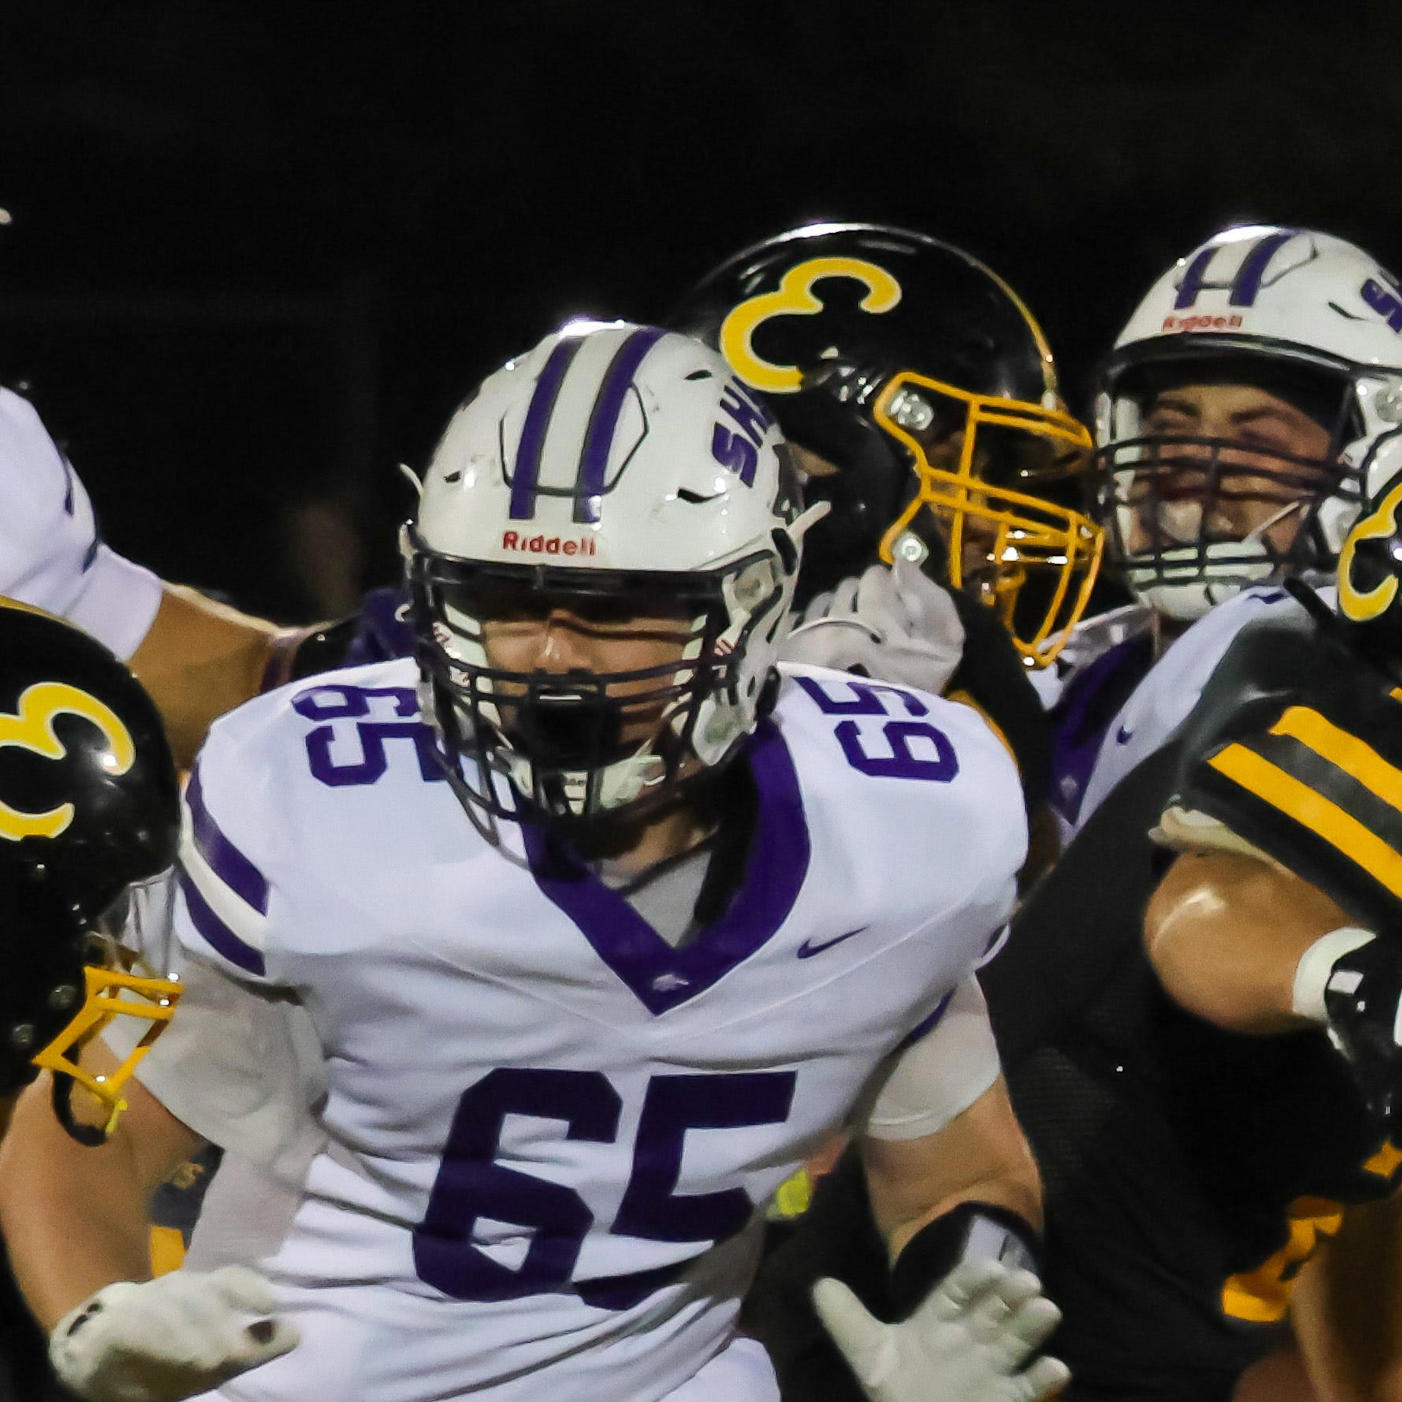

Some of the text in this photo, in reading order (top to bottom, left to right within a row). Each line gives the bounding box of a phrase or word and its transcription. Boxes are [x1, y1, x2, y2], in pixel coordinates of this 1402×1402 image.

[502, 531, 595, 556] Riddell
[291, 684, 450, 788] 65
[789, 675, 960, 783] 65
[412, 1066, 799, 1312] 65
